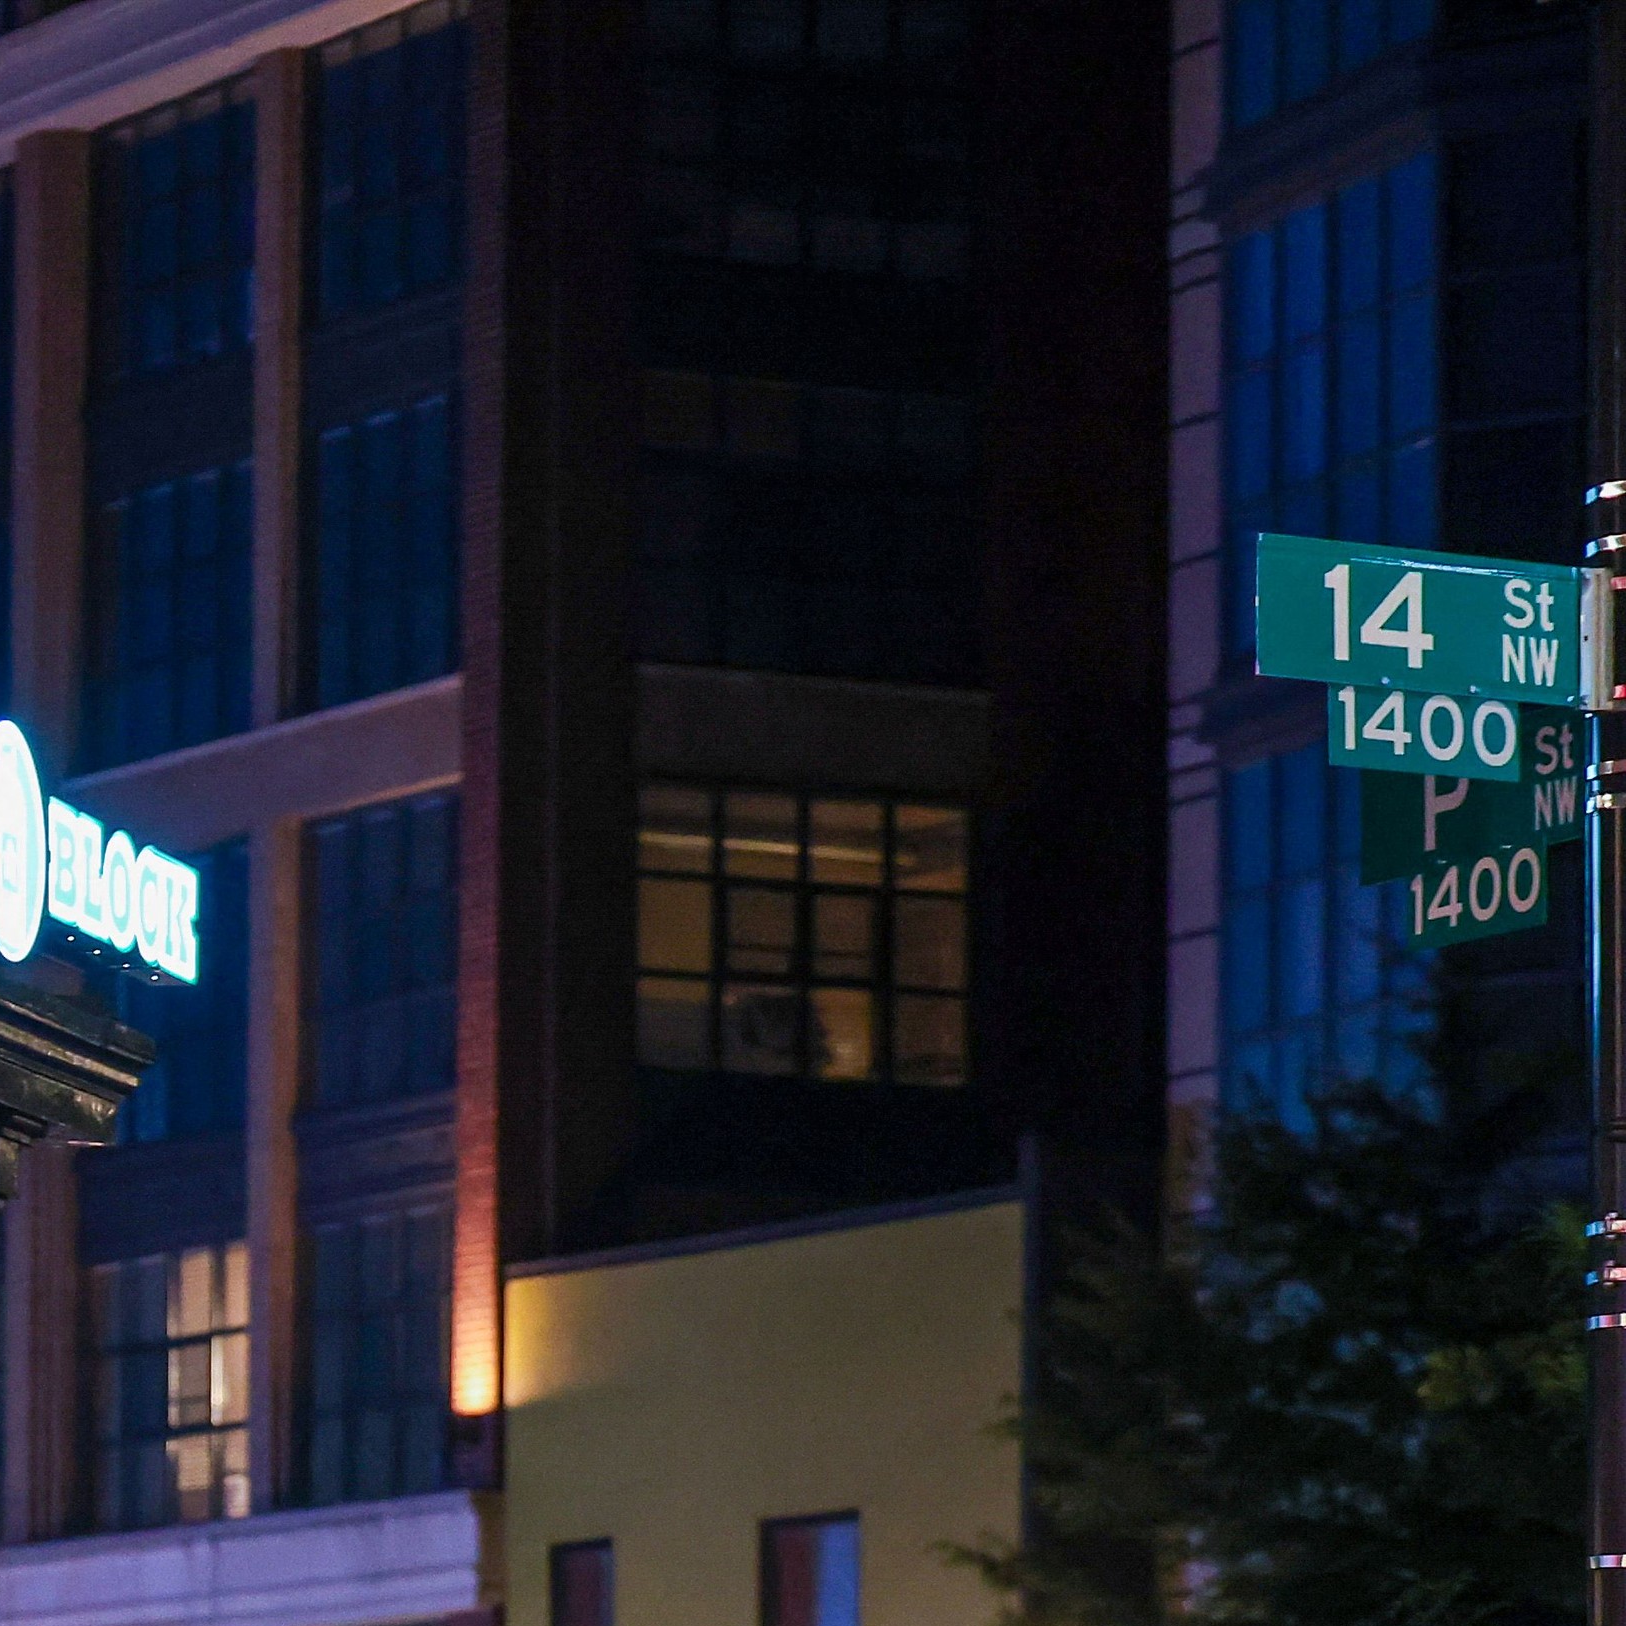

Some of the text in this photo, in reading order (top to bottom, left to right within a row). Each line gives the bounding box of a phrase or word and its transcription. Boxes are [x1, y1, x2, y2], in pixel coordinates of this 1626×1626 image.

[1324, 564, 1555, 669] 14 St
[1501, 634, 1558, 688] NW
[1338, 685, 1517, 767] 1400
[1424, 721, 1574, 852] P St
[1534, 777, 1578, 832] NW
[51, 806, 195, 976] BLOCK
[1411, 847, 1541, 936] 1400
